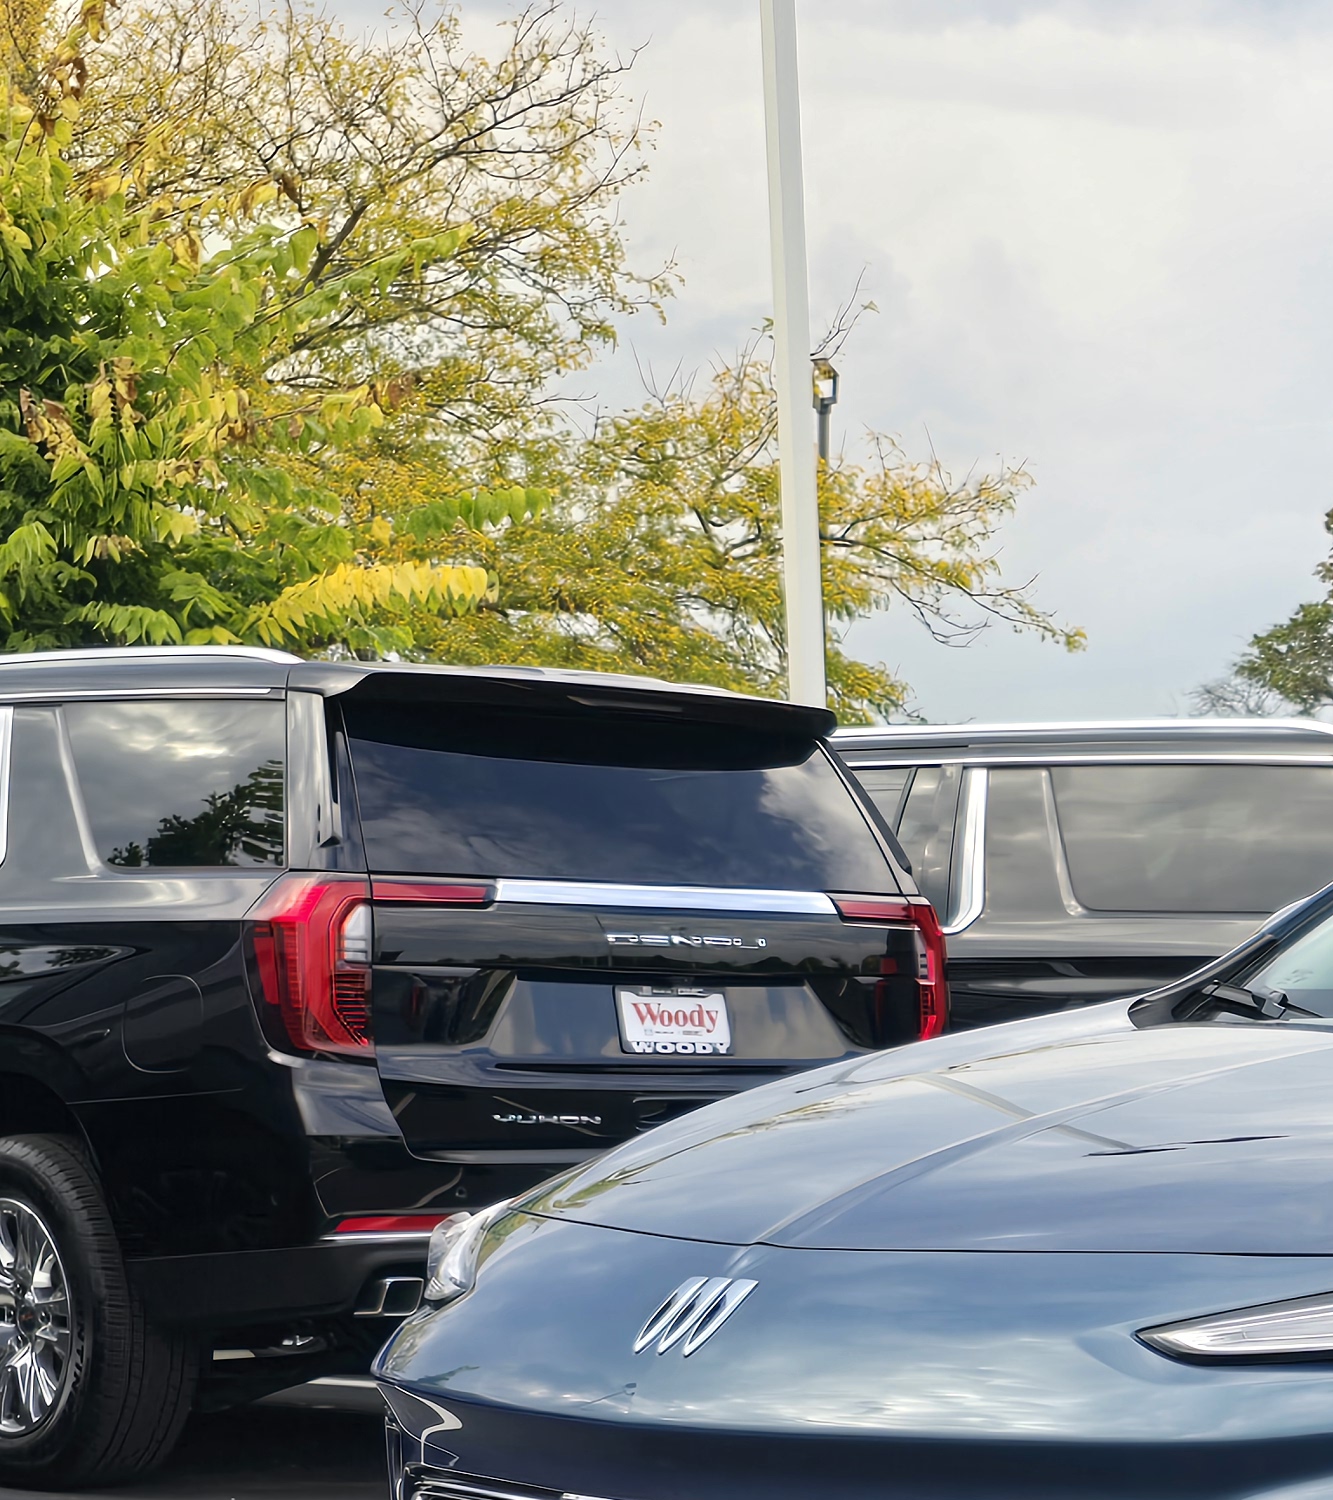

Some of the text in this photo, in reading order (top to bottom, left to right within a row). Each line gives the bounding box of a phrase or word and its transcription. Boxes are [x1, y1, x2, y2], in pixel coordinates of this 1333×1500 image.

[606, 933, 767, 950] DENALI
[630, 1002, 719, 1034] Woody
[631, 1041, 730, 1054] WOODY
[492, 1114, 602, 1125] YUKON
